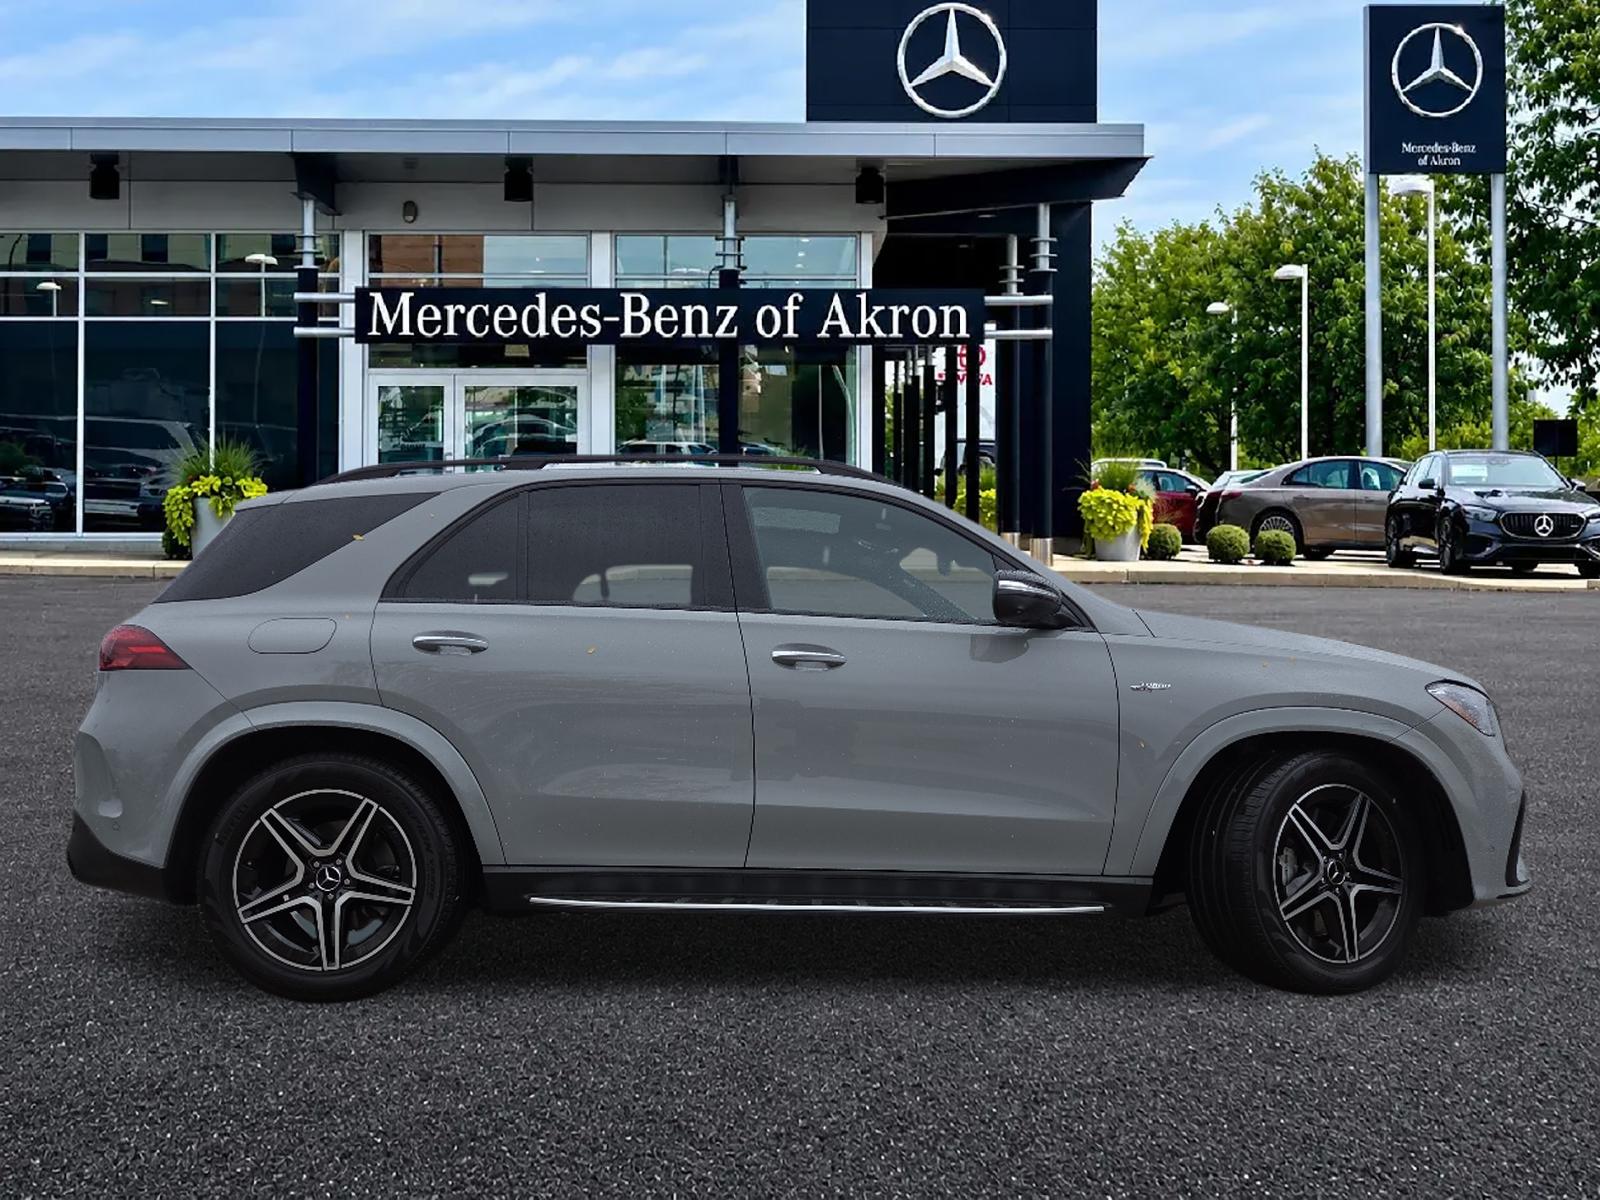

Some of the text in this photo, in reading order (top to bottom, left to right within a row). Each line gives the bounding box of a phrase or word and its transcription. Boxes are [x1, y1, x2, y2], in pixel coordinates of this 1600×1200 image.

[1401, 141, 1477, 154] Mercedes-Benz
[1417, 154, 1461, 166] of Akron
[367, 292, 970, 338] Mercedes-Benz of Akron
